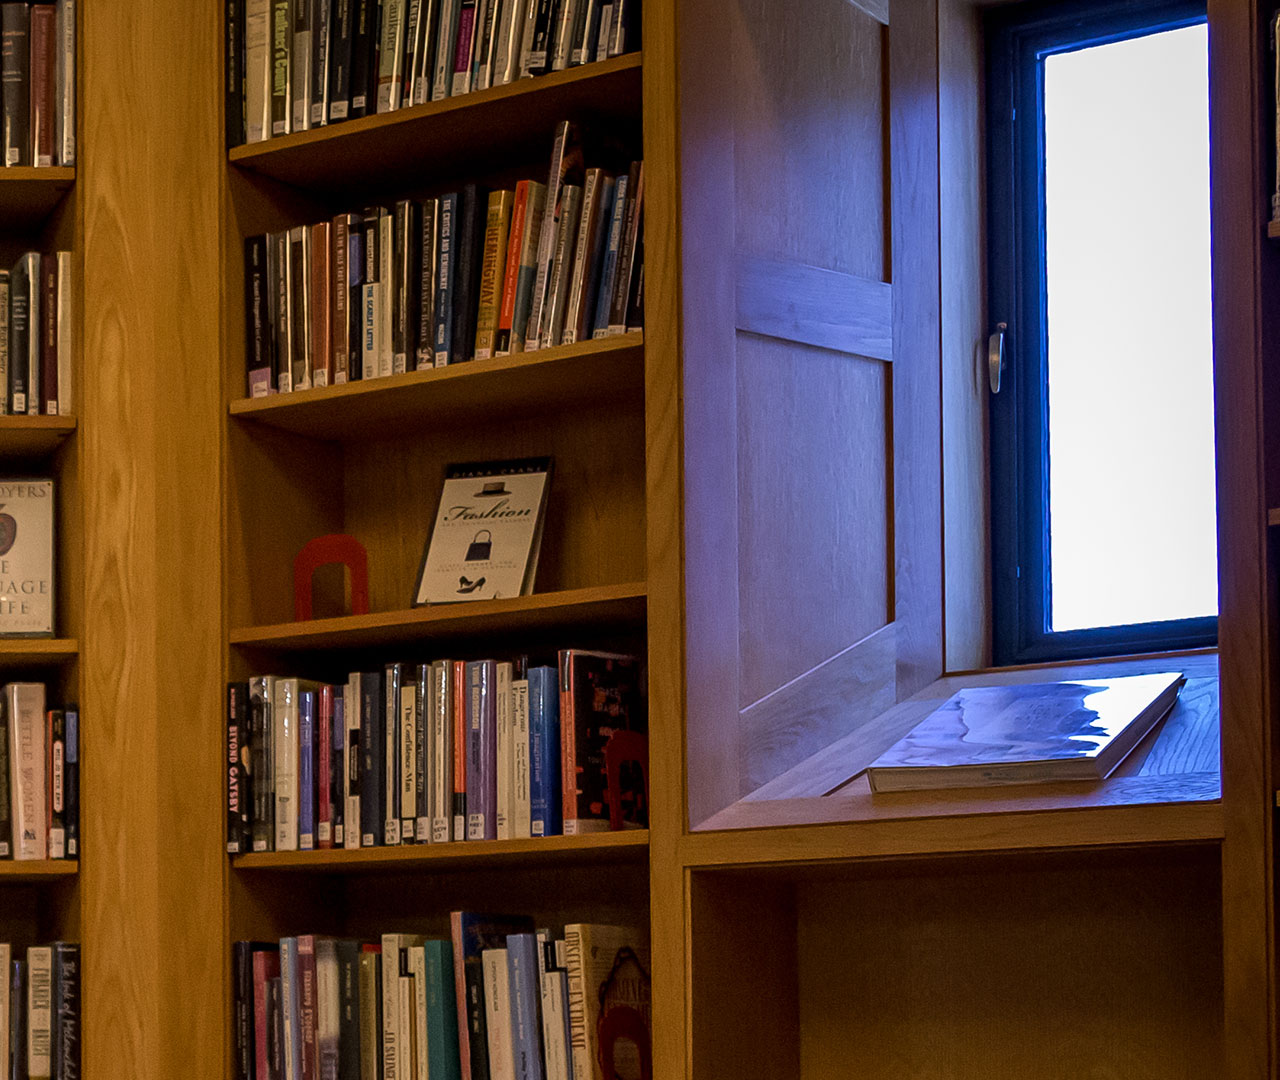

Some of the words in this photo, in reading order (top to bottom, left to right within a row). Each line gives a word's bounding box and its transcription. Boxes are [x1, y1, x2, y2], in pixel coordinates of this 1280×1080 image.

[274, 2, 289, 58] Faulkner's
[273, 60, 287, 96] County
[481, 228, 500, 305] HEMINGWAY
[444, 498, 531, 521] Fashion
[21, 710, 33, 760] LITTLE
[229, 726, 238, 763] BEYOND
[23, 767, 34, 823] WOMEN
[229, 766, 239, 813] GATSBY
[63, 962, 75, 977] The
